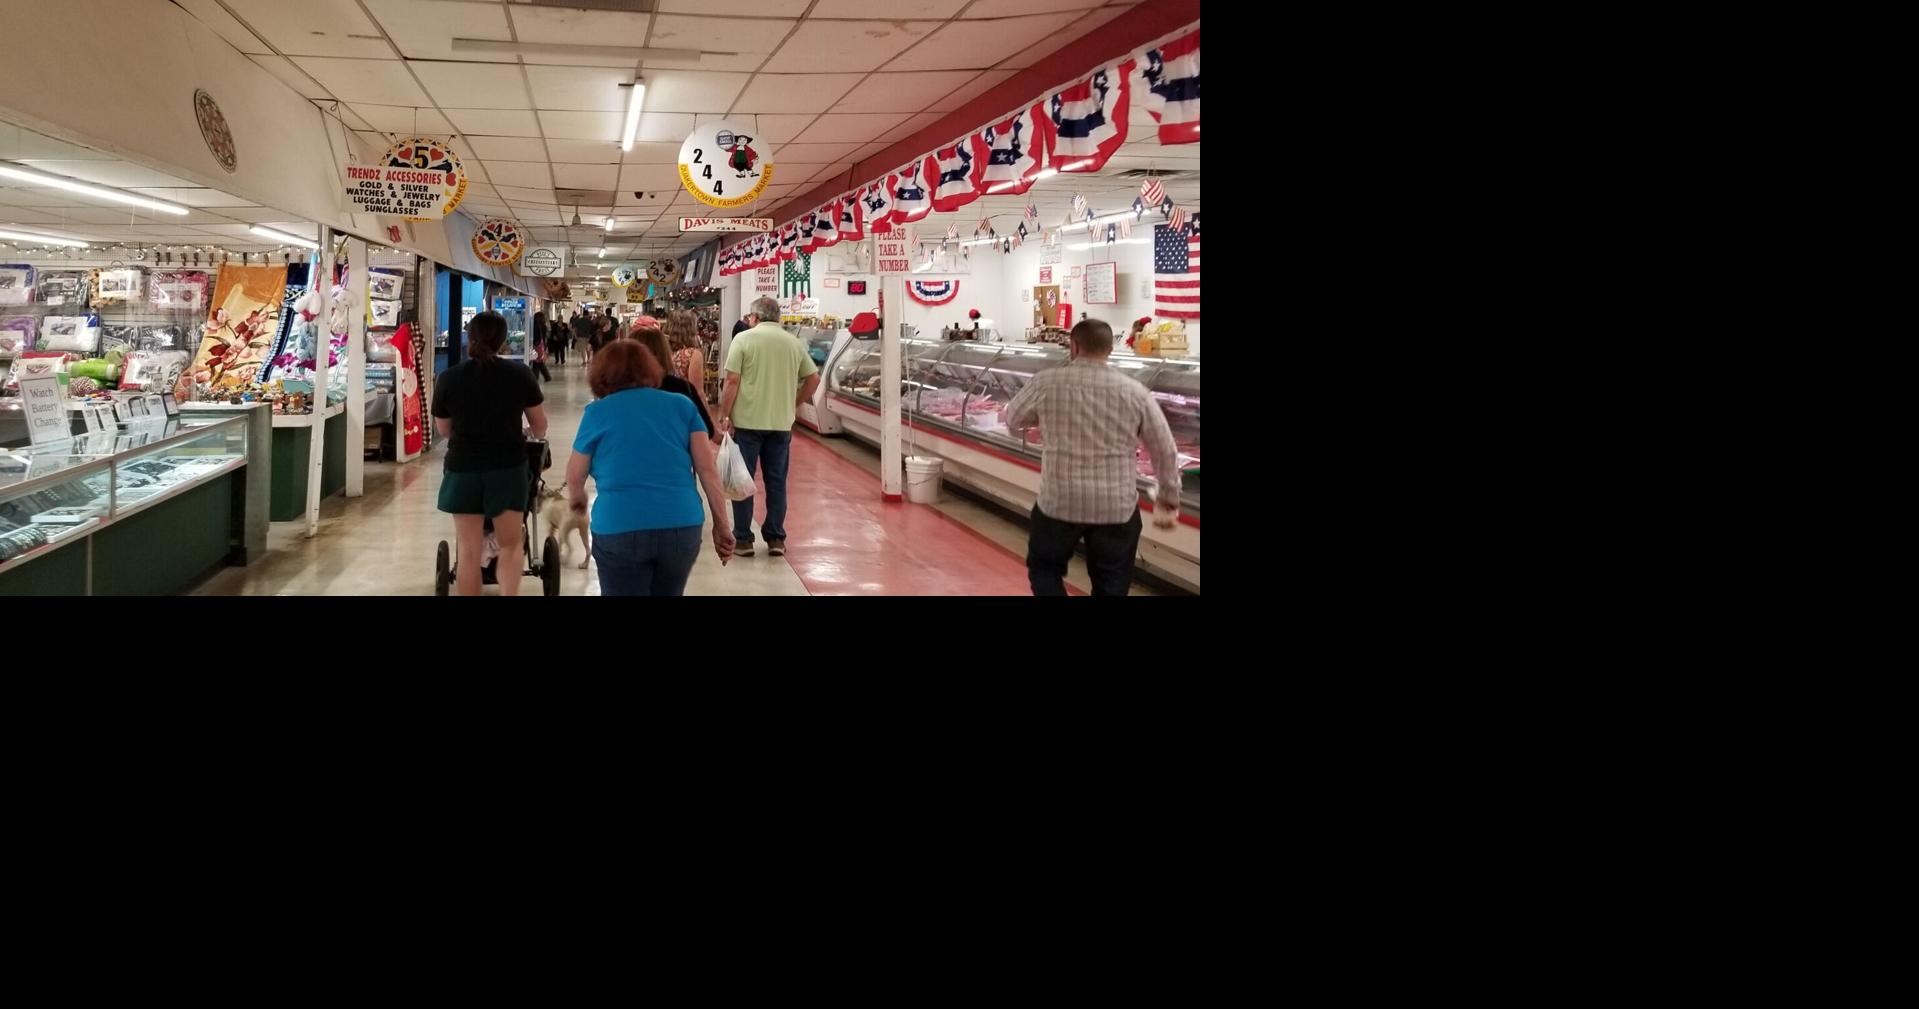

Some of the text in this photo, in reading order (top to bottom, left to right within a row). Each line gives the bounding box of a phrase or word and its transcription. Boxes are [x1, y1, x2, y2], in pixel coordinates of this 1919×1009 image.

[414, 146, 429, 169] 5
[347, 167, 442, 185] TRENDZ ACCESSORIES
[359, 181, 382, 189] GOLD
[400, 184, 429, 193] SILVER
[680, 164, 773, 207] QUAKERTOWN FARMERS MARKET
[345, 188, 441, 202] WATCHES & JEWELRY
[447, 178, 467, 209] MARKET
[353, 197, 432, 209] LUGGAGE & BAGS
[364, 205, 419, 216] SUNGLASSES
[493, 223, 503, 237] 4
[684, 218, 769, 230] DAVIS MEATS
[878, 228, 906, 241] PLEASE
[878, 244, 905, 256] TAKE A
[757, 267, 776, 275] PLEASE
[878, 259, 909, 272] NUMBER
[29, 387, 55, 398] Watch
[31, 403, 58, 413] Battery
